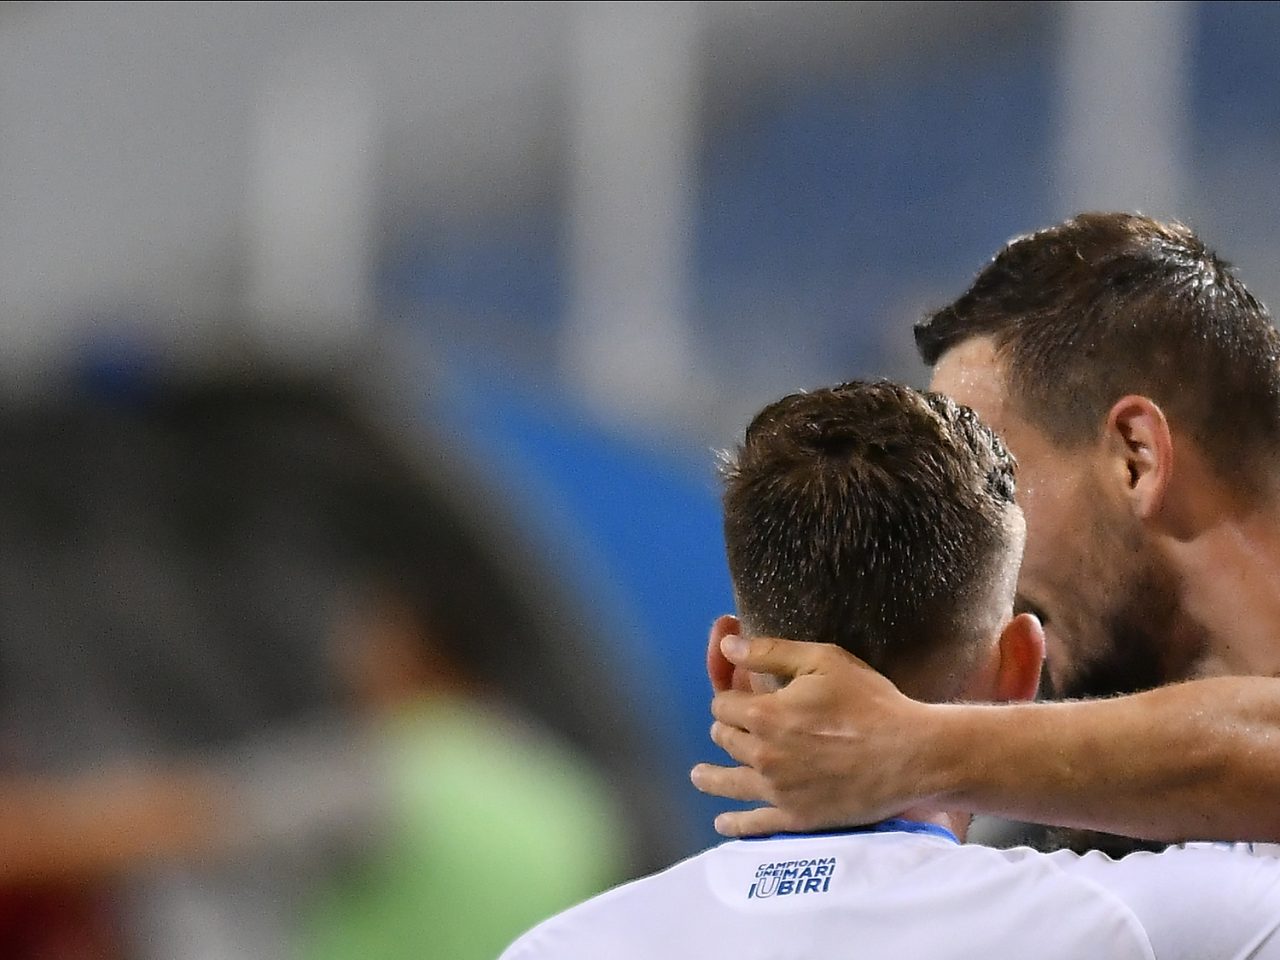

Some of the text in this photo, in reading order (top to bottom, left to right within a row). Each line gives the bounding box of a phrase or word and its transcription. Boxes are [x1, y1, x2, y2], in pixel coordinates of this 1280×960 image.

[758, 857, 836, 871] CAMPIOANA
[755, 865, 835, 880] UNEI MARI
[748, 877, 831, 899] IUBIRI
